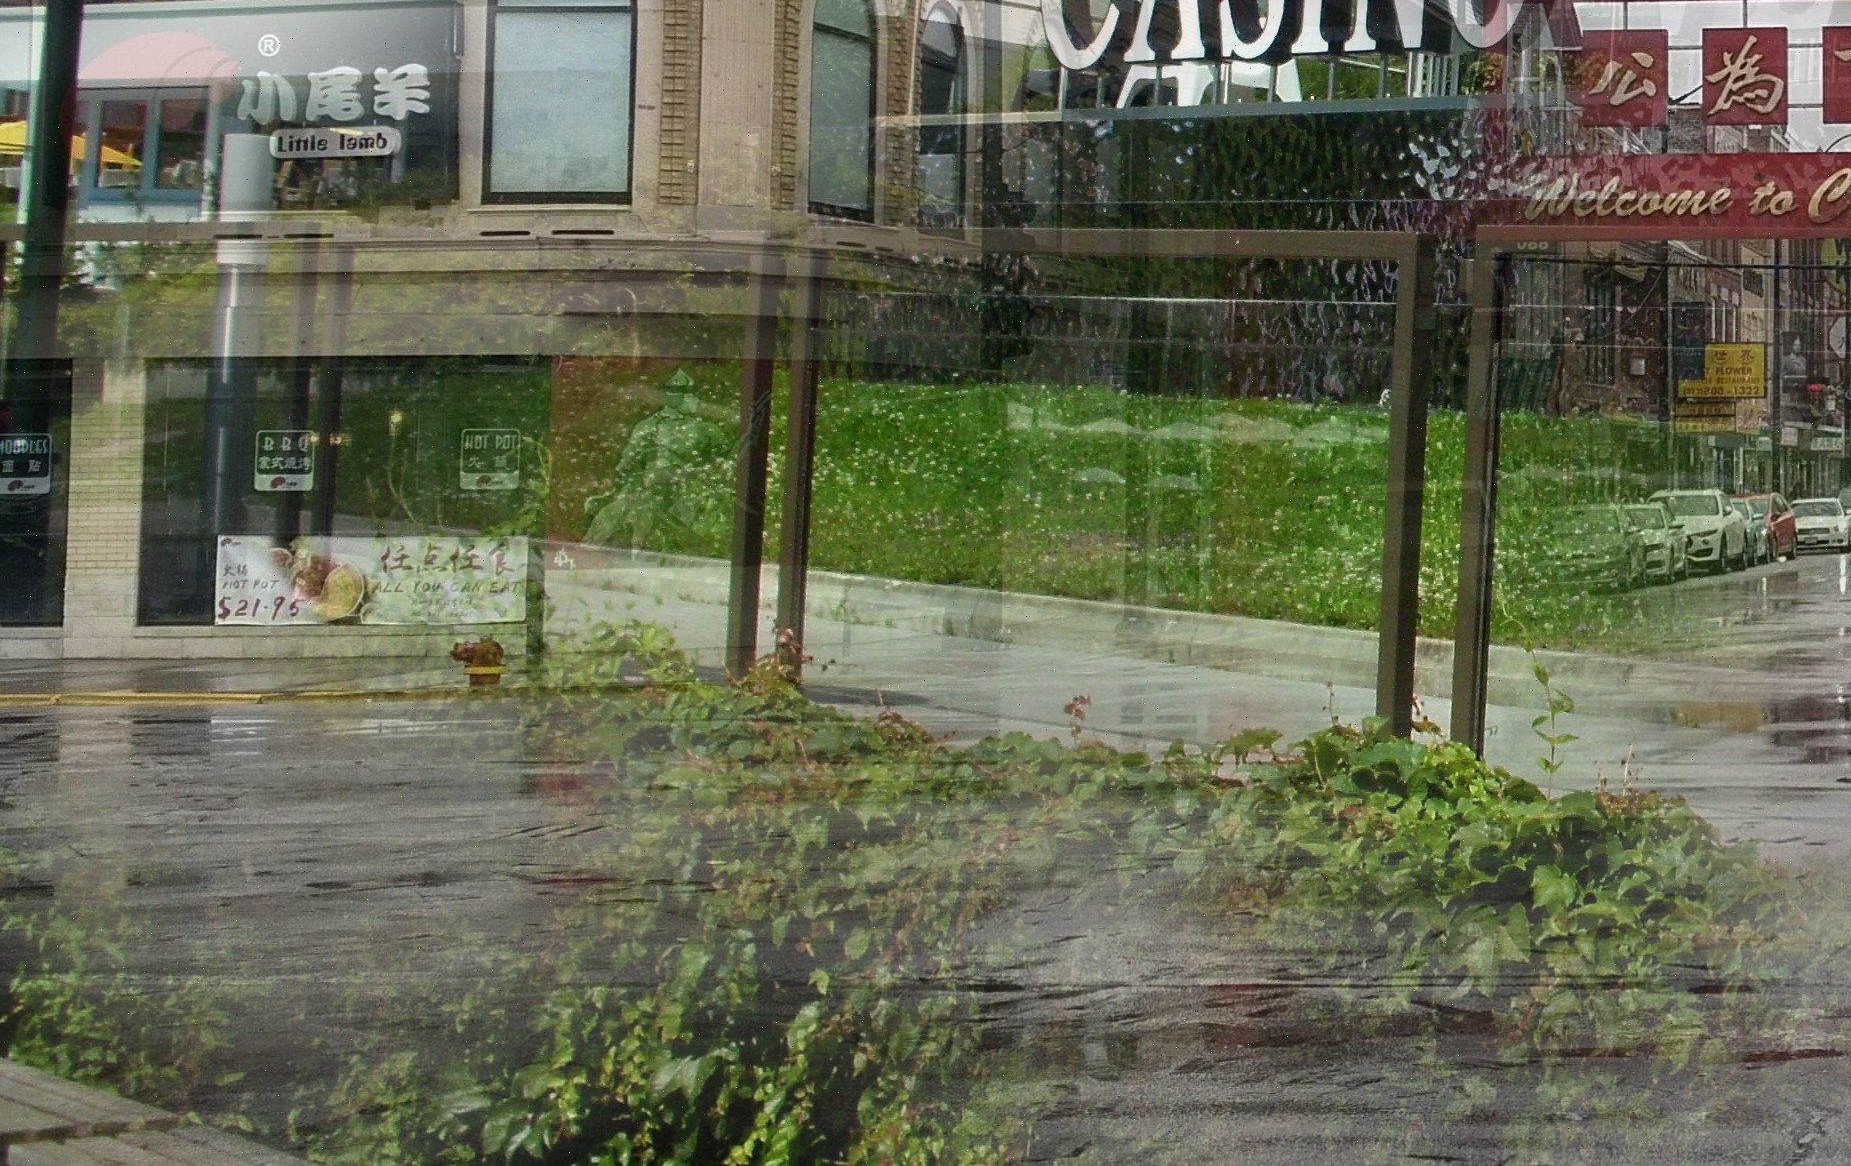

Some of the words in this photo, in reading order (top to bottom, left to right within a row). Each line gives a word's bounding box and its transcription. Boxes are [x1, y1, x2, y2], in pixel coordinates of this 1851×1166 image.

[237, 62, 431, 125] 小尾羊
[277, 134, 328, 153] Little
[339, 132, 388, 151] lamb
[1524, 173, 1734, 220] Welcome
[1749, 180, 1799, 216] to
[1715, 366, 1753, 375] FLOWER
[464, 434, 489, 450] HOT
[494, 434, 518, 450] POT
[221, 579, 250, 590] HOT
[252, 579, 280, 590] POT
[372, 581, 404, 594] ALL
[413, 580, 442, 593] YOU
[449, 581, 482, 593] CAN
[488, 580, 523, 594] EAT
